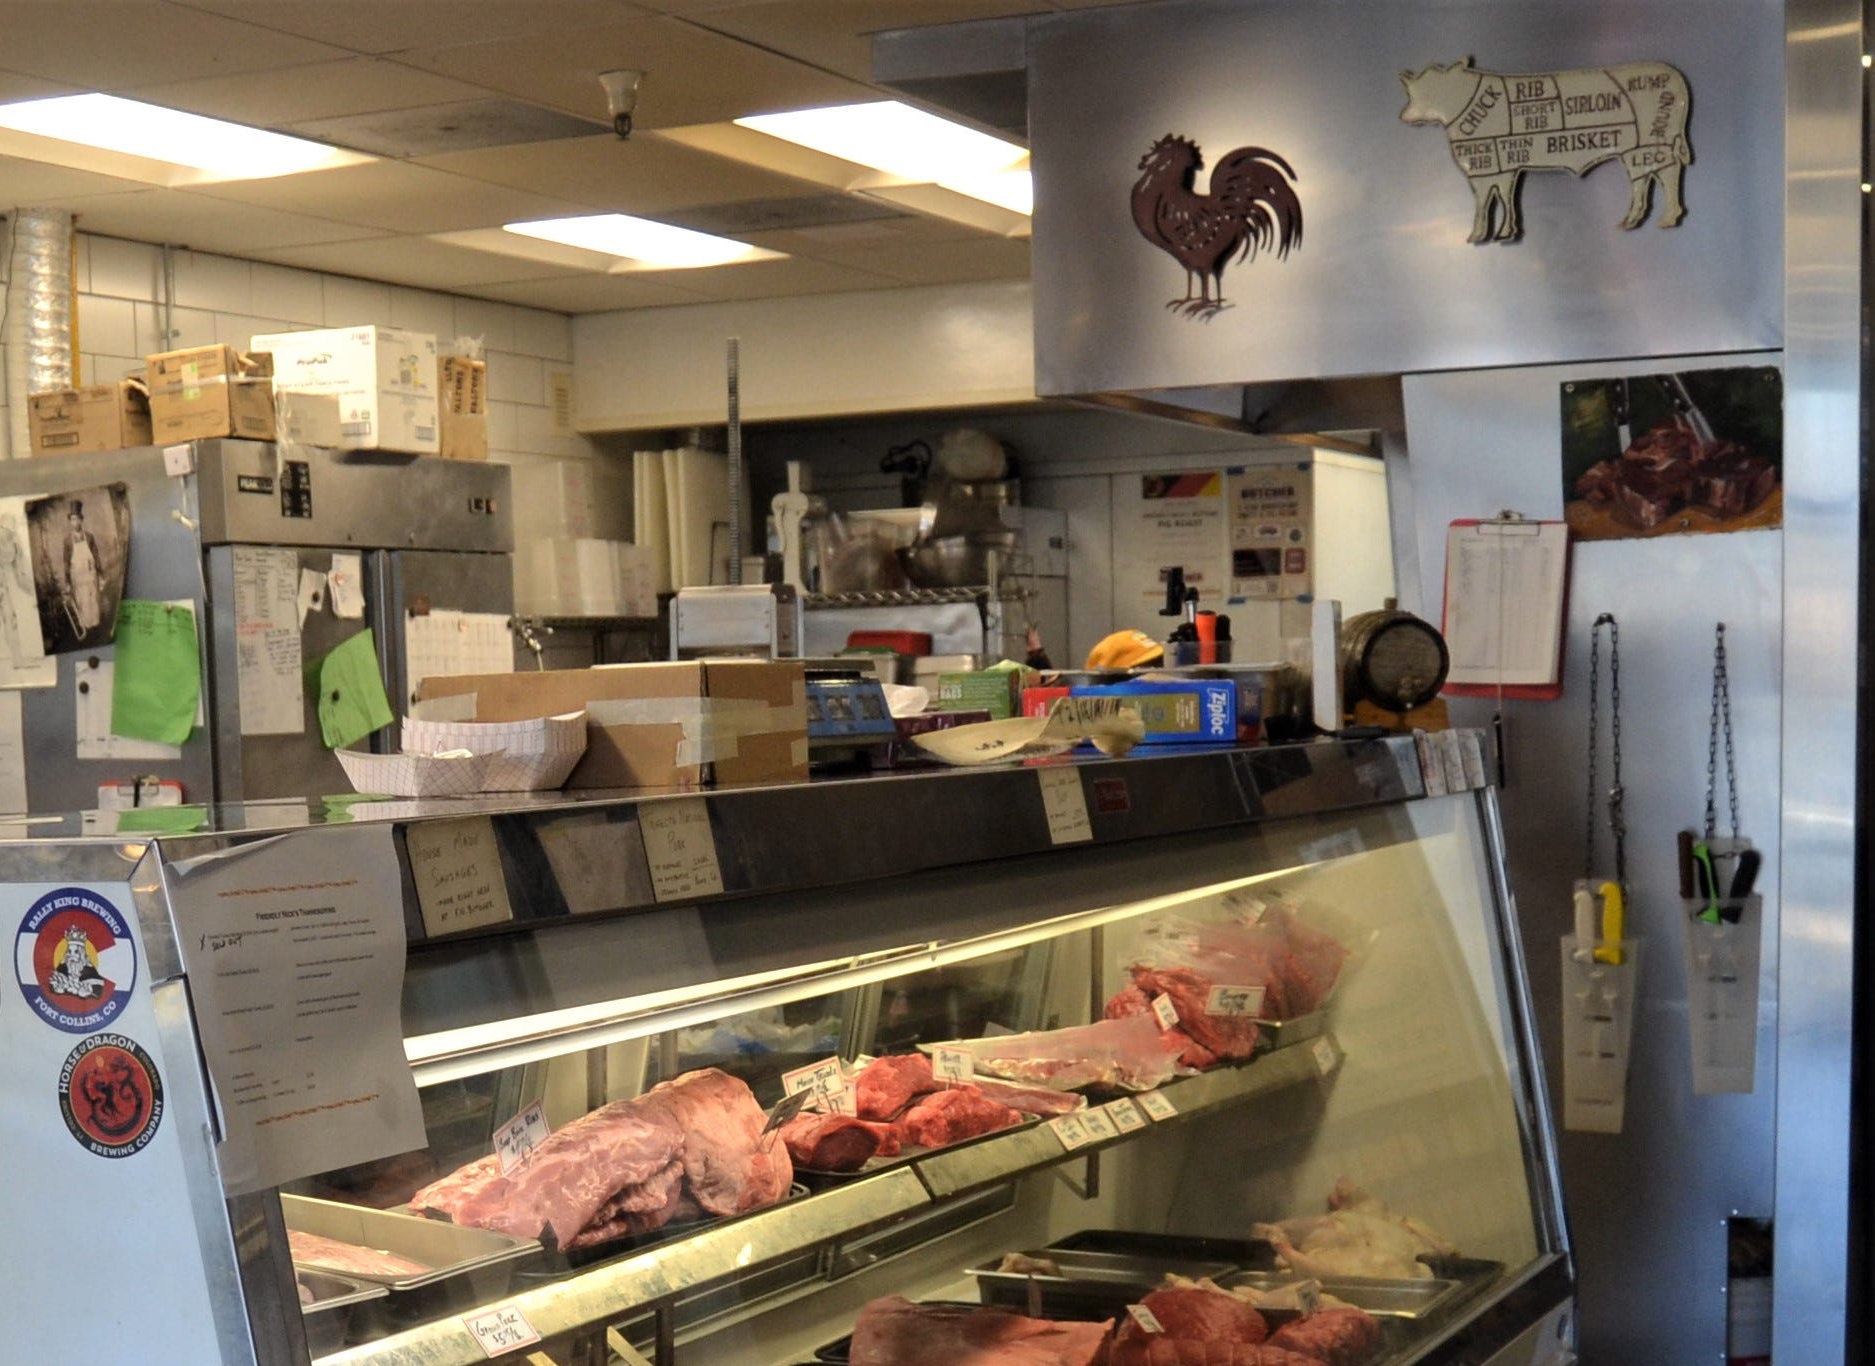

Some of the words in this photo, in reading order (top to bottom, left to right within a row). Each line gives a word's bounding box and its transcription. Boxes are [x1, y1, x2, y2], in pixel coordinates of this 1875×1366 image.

[1515, 79, 1546, 99] RIB
[1627, 72, 1671, 93] RUMP
[1458, 84, 1504, 136] CHUCK
[1513, 100, 1556, 117] SHORT
[1564, 92, 1623, 116] SIRLOIN
[1649, 91, 1676, 139] ROUND
[1525, 115, 1549, 131] RIB
[1454, 142, 1493, 158] THICK
[1499, 136, 1534, 151] THIN
[1546, 129, 1623, 154] BRISKET
[1469, 155, 1492, 171] RIB
[1506, 149, 1531, 165] RIB
[1631, 151, 1667, 167] LEG
[1209, 690, 1228, 737] Ziploc
[430, 864, 479, 889] SAUSAGES
[28, 902, 53, 930] RALLY
[53, 896, 80, 909] KING
[81, 897, 122, 936] BREWING
[34, 996, 59, 1021] FORT
[102, 1000, 117, 1016] CO
[58, 1049, 83, 1094] HORSE
[85, 1034, 137, 1053] DRAGON
[90, 1141, 135, 1157] BREWING
[135, 1099, 163, 1148] COMPANY
